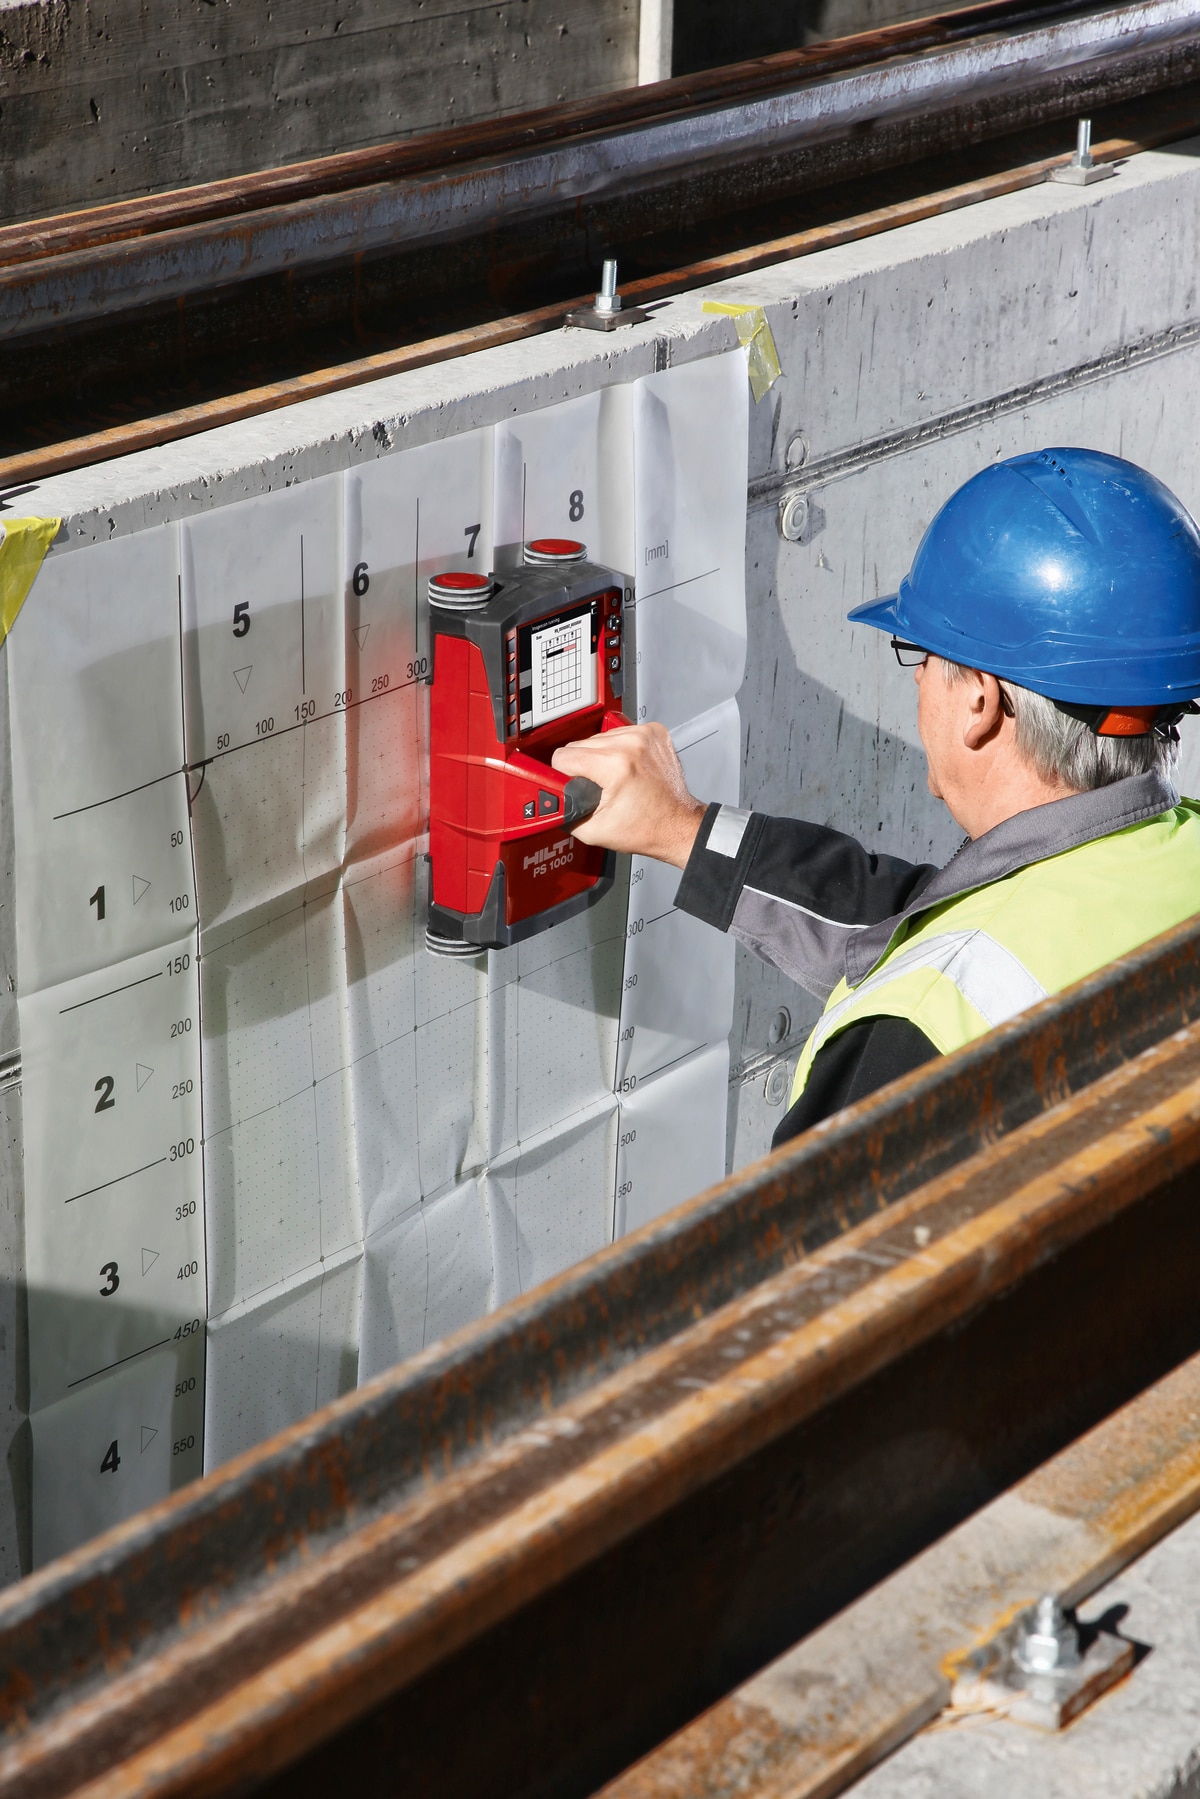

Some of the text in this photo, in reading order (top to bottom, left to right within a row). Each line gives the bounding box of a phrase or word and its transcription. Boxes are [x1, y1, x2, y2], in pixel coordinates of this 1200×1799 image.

[569, 490, 585, 523] 8
[464, 523, 482, 559] 7
[645, 540, 669, 566] [mm]
[352, 562, 370, 596] 6
[232, 601, 251, 638] 5
[216, 657, 428, 750] 50 100 150 200 250 300
[170, 830, 184, 848] 50
[523, 837, 575, 870] HILTI
[533, 852, 574, 878] PS 1000
[631, 868, 644, 886] 250
[89, 885, 106, 921] 1
[168, 894, 190, 914] 100
[627, 918, 644, 939] 300
[166, 953, 191, 977] 150
[170, 1017, 192, 1039] 200
[94, 1075, 116, 1114] 2
[172, 1079, 194, 1100] 250
[169, 1137, 195, 1162] 300
[620, 1129, 637, 1148] 500
[175, 1200, 197, 1221] 350
[99, 1261, 121, 1297] 3
[176, 1260, 199, 1282] 400
[173, 1318, 201, 1342] 450
[174, 1377, 197, 1398] 500
[99, 1439, 121, 1474] 4
[172, 1434, 195, 1456] 550
